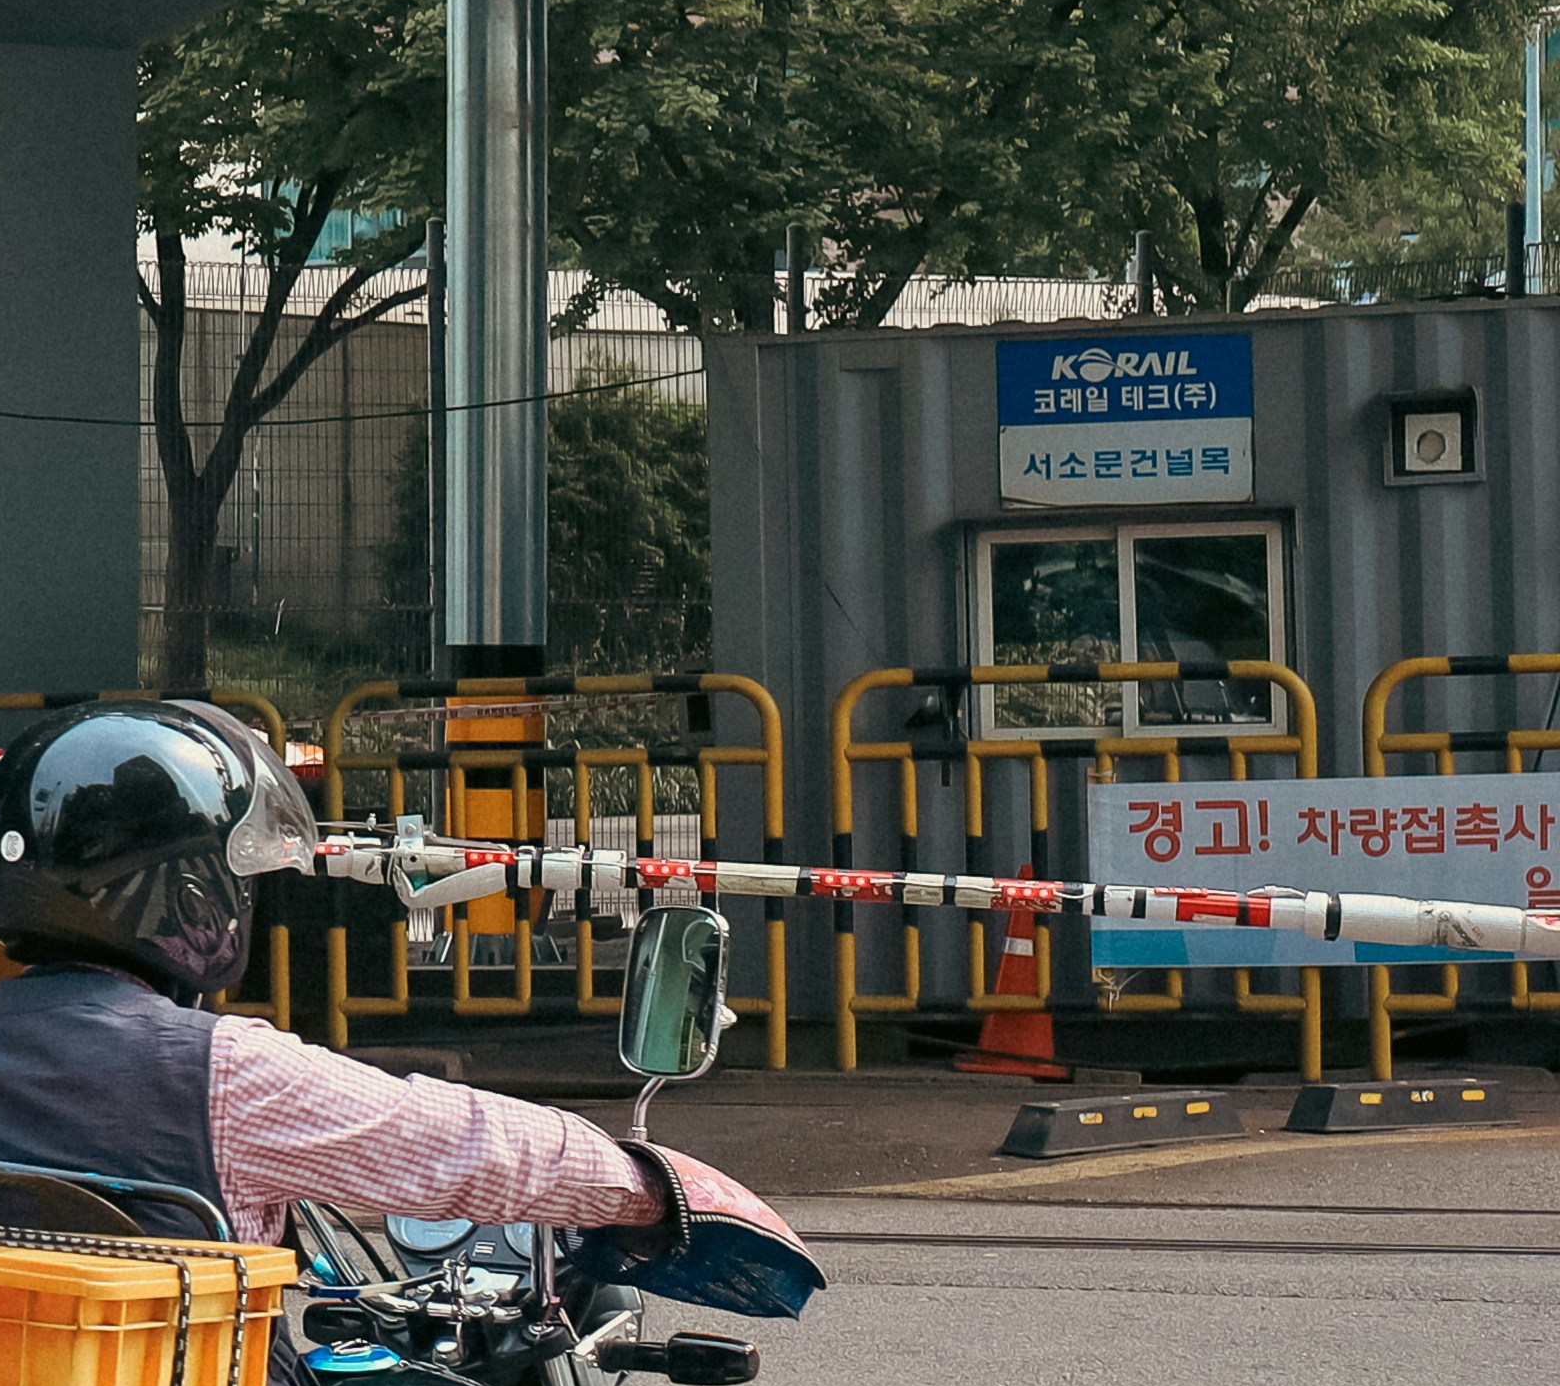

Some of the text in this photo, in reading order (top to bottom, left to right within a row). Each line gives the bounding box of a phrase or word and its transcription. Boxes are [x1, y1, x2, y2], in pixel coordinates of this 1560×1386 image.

[1050, 347, 1198, 383] KORAIL
[1033, 380, 1217, 414] 코레일 테크(주)
[1022, 446, 1230, 481] 서소문건널목
[1127, 799, 1271, 863] 경고!
